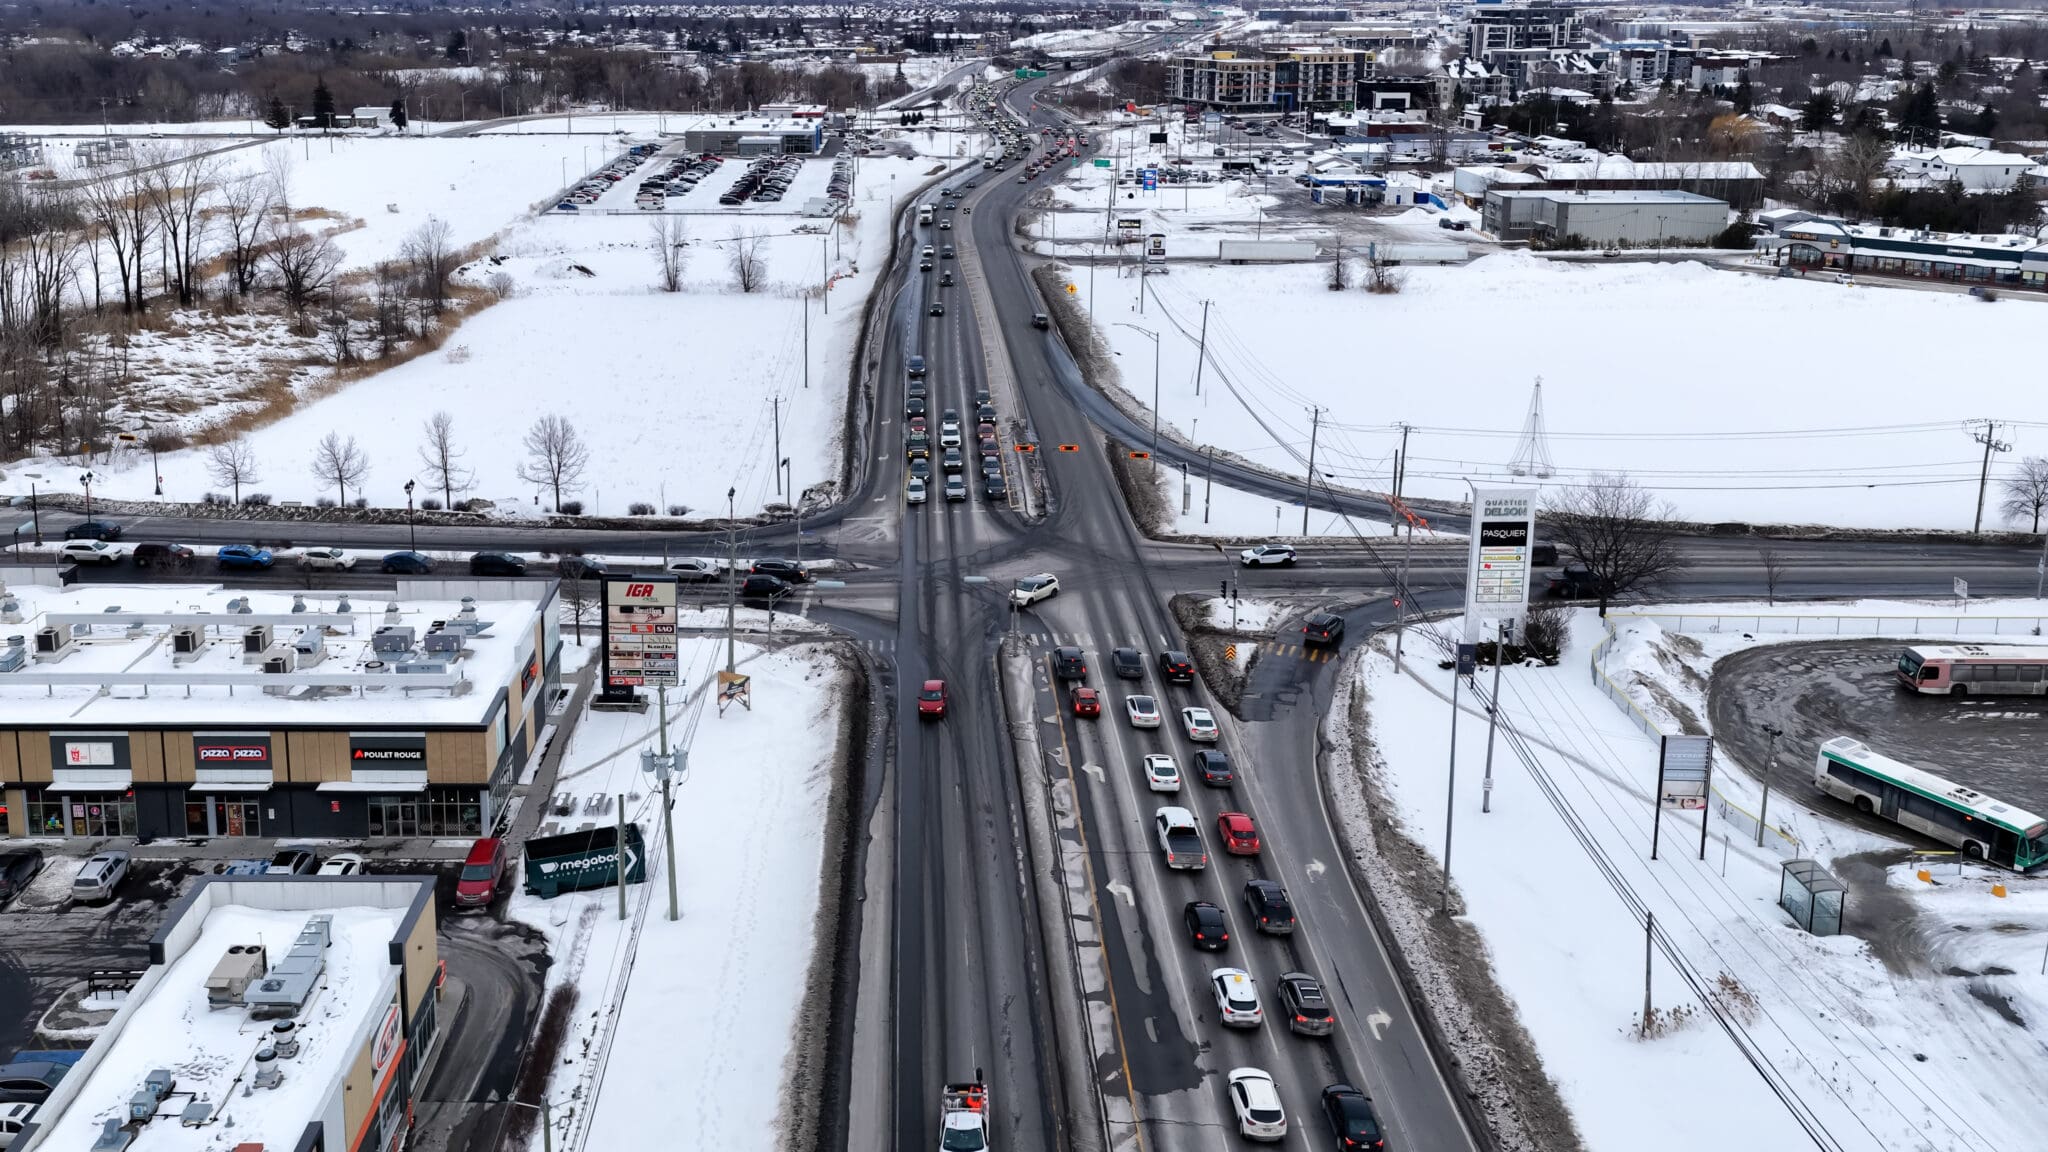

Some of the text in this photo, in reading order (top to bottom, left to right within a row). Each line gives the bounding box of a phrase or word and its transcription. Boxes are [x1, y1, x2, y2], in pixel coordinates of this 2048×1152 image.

[1484, 507, 1528, 516] DELSON
[1482, 530, 1526, 539] PASQUIER
[625, 583, 655, 597] IGA
[201, 749, 263, 760] pizza pizza
[364, 751, 421, 759] POULET ROUGE
